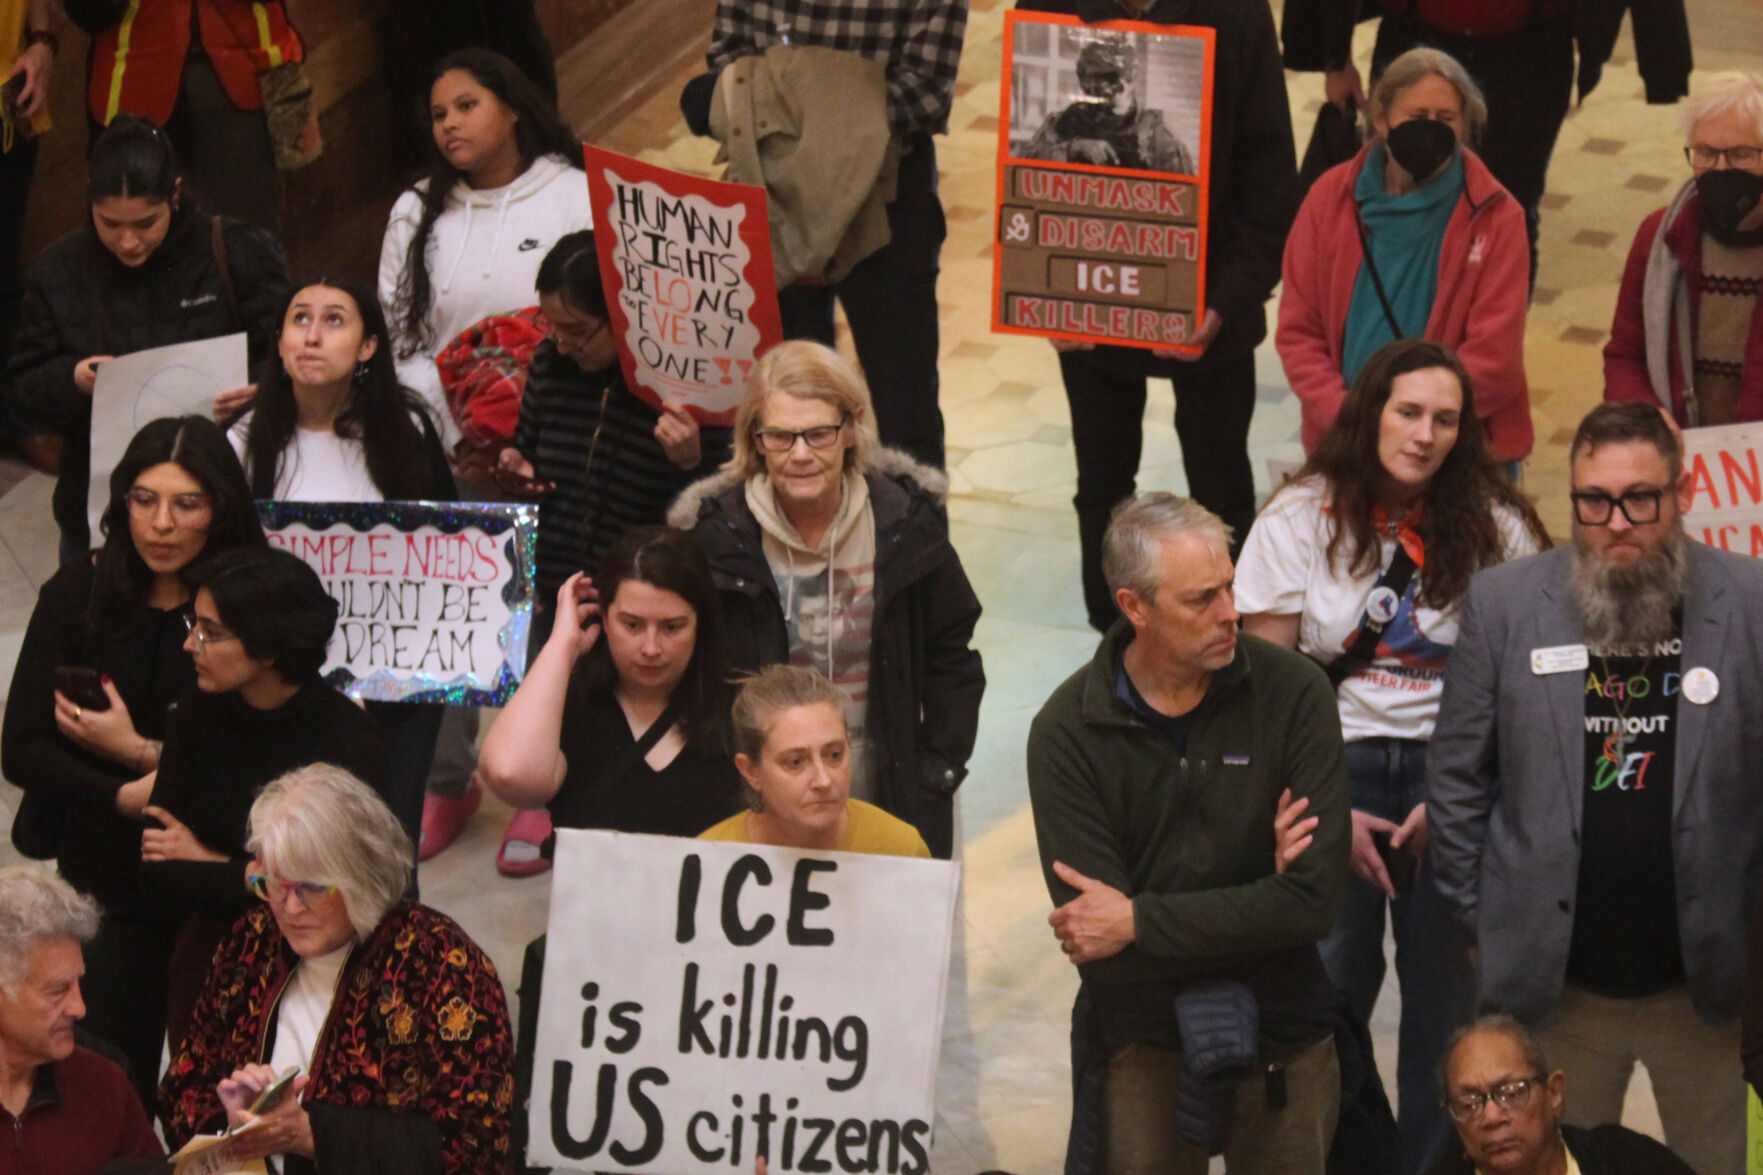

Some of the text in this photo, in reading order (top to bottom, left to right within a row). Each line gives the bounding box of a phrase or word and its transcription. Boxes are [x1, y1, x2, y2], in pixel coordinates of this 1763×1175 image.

[617, 184, 732, 249] HUMAN
[1022, 170, 1187, 216] UNMASK
[618, 220, 740, 287] RIGHTS
[1005, 213, 1198, 261] & DISARM
[619, 256, 744, 323] BELONG
[1076, 262, 1141, 295] ICE
[638, 300, 735, 350] EVERY
[1016, 297, 1187, 343] KILLERS
[1684, 448, 1762, 510] AN
[402, 534, 499, 583] NEEDS
[437, 582, 489, 623] BE
[339, 622, 476, 672] DREAM
[1654, 637, 1682, 657] NO
[1584, 671, 1651, 700] AGO
[676, 853, 838, 947] ICE
[581, 961, 868, 1093] is killing
[550, 1060, 930, 1175] US citizens
